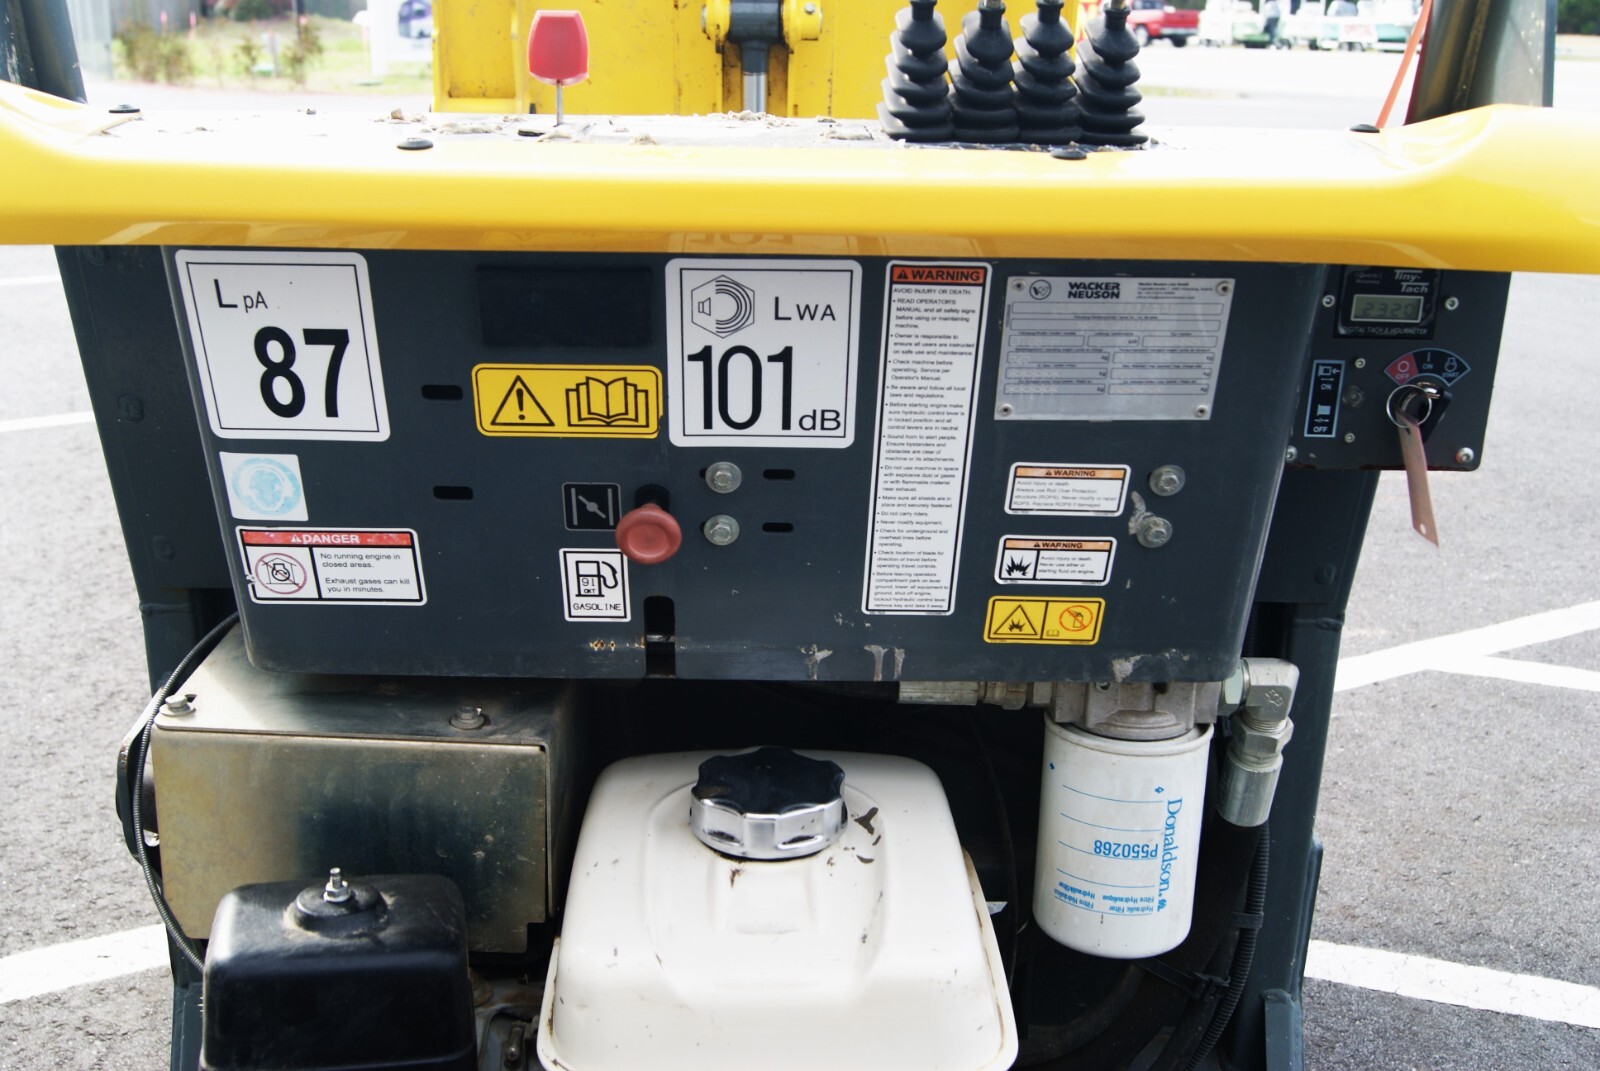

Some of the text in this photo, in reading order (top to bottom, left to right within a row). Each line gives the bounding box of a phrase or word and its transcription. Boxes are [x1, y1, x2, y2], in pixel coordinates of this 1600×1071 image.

[911, 270, 980, 281] WARNING
[1068, 281, 1121, 291] WACKER
[1401, 282, 1430, 293] Tach
[1067, 290, 1120, 300] NEUSON
[254, 326, 350, 418] 87
[687, 345, 841, 431] 101 dB
[302, 535, 360, 544] DANGER
[365, 553, 392, 561] engine
[582, 578, 595, 586] 91
[573, 603, 621, 611] GASOLINE
[1094, 839, 1159, 859] P550268
[1079, 899, 1094, 909] Filtro
[1102, 895, 1138, 903] Hydraulique
[1109, 905, 1124, 913] Filter
